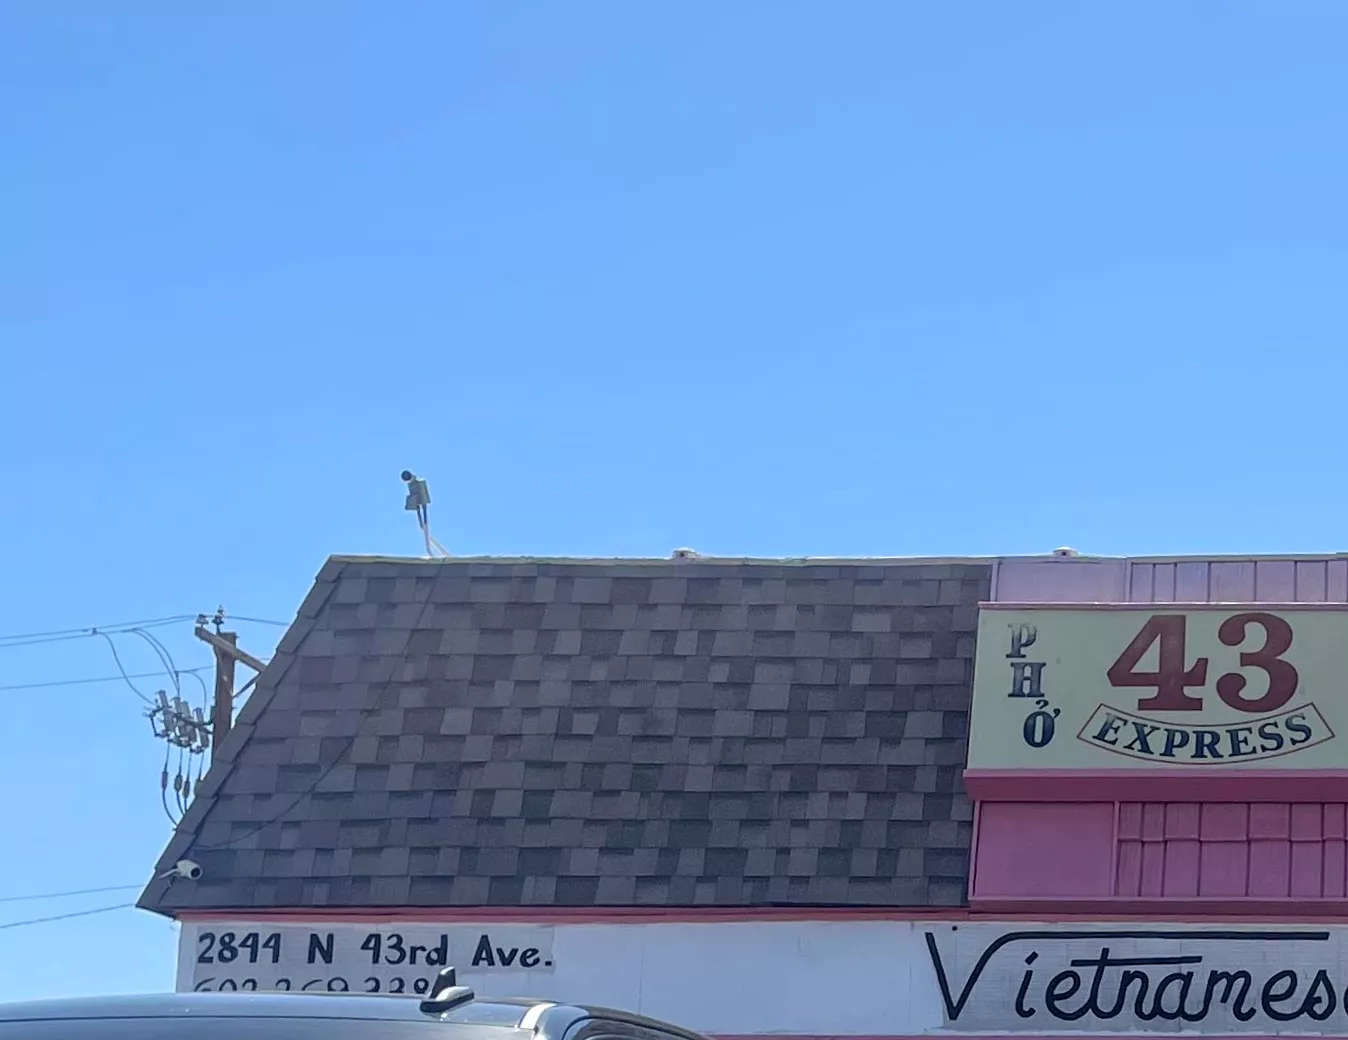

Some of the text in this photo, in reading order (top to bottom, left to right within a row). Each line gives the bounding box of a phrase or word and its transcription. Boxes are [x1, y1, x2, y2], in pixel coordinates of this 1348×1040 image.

[1106, 612, 1299, 713] 43
[1091, 712, 1314, 759] EXPRESS
[197, 932, 552, 968] 2844 N 43rd Ave.
